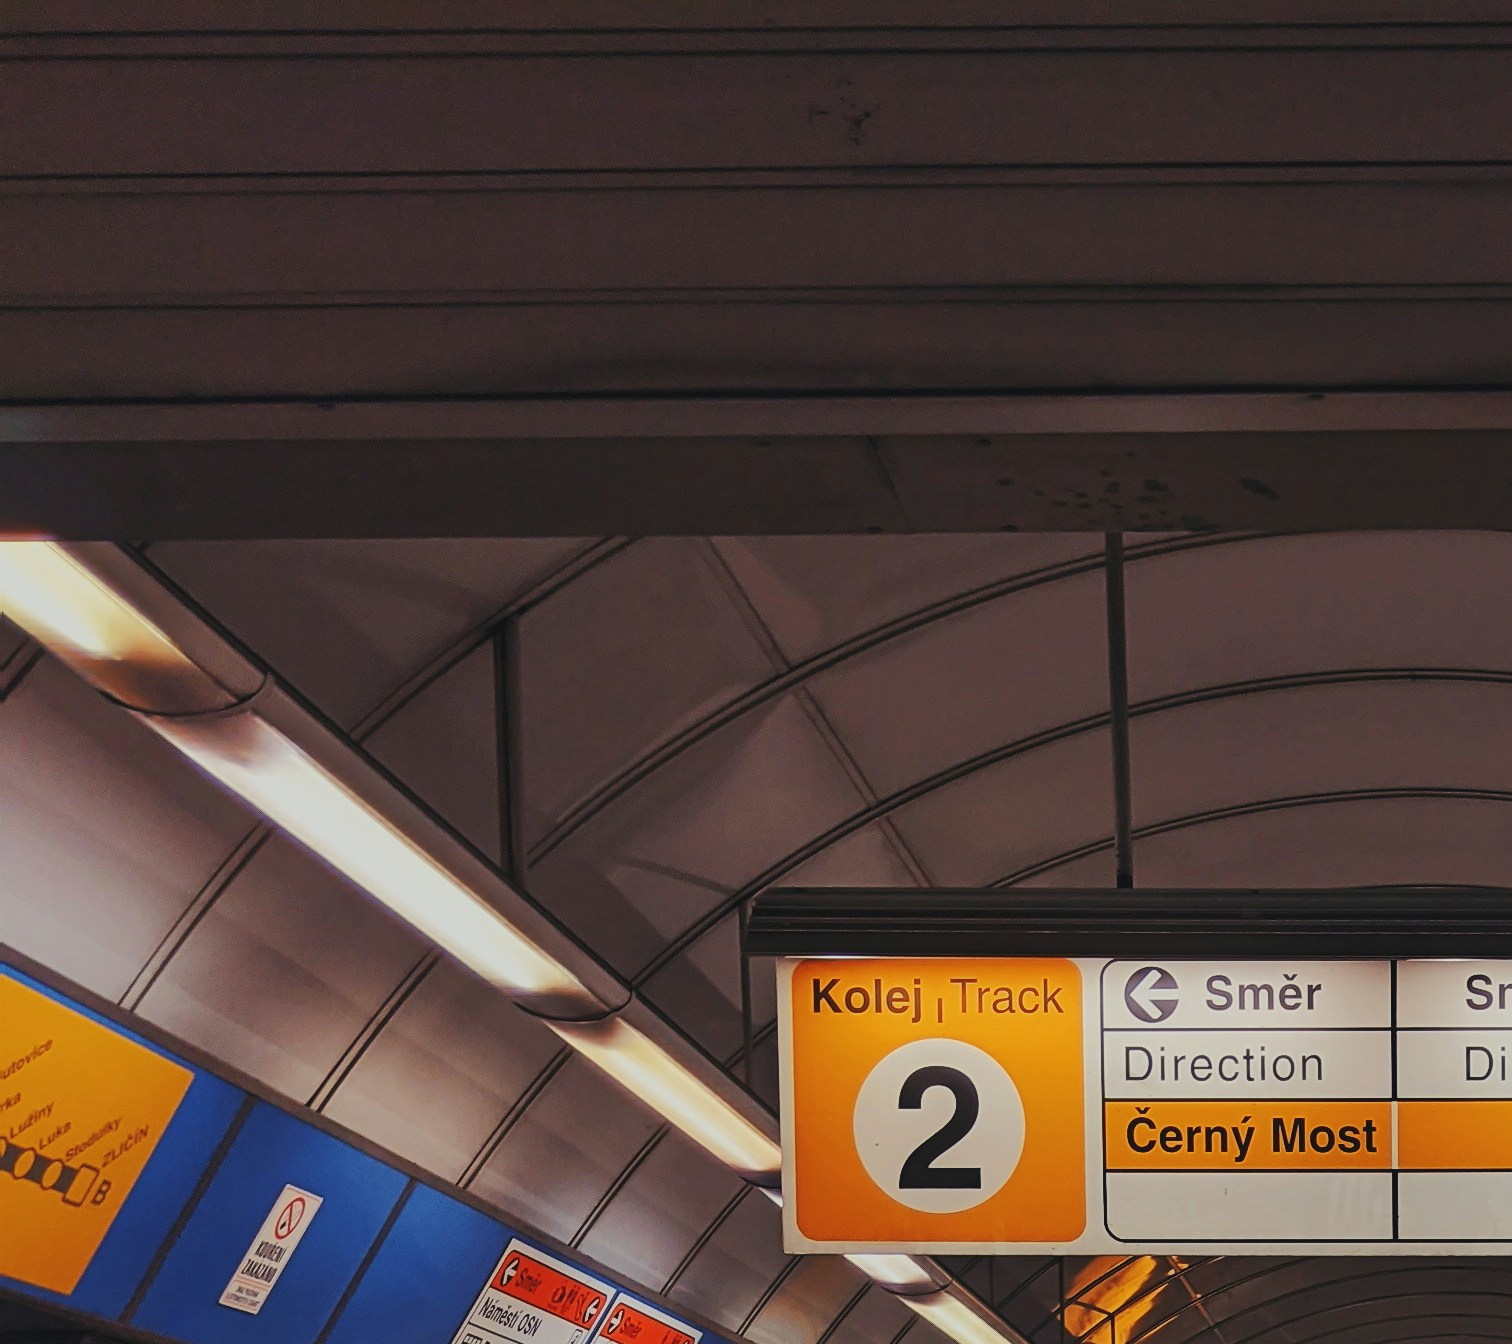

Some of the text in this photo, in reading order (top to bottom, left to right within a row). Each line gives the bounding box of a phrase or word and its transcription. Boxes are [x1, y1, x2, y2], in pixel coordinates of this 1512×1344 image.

[812, 978, 1064, 1023] Kolej Track
[1206, 973, 1322, 1010] Směr
[0, 1039, 53, 1079] utovice
[1125, 1045, 1323, 1082] Direction
[38, 1121, 72, 1151] Luka
[898, 1065, 982, 1189] 2
[1126, 1106, 1378, 1163] Černý Most
[91, 1179, 112, 1206] B
[478, 1296, 543, 1338] Náměstí OSN
